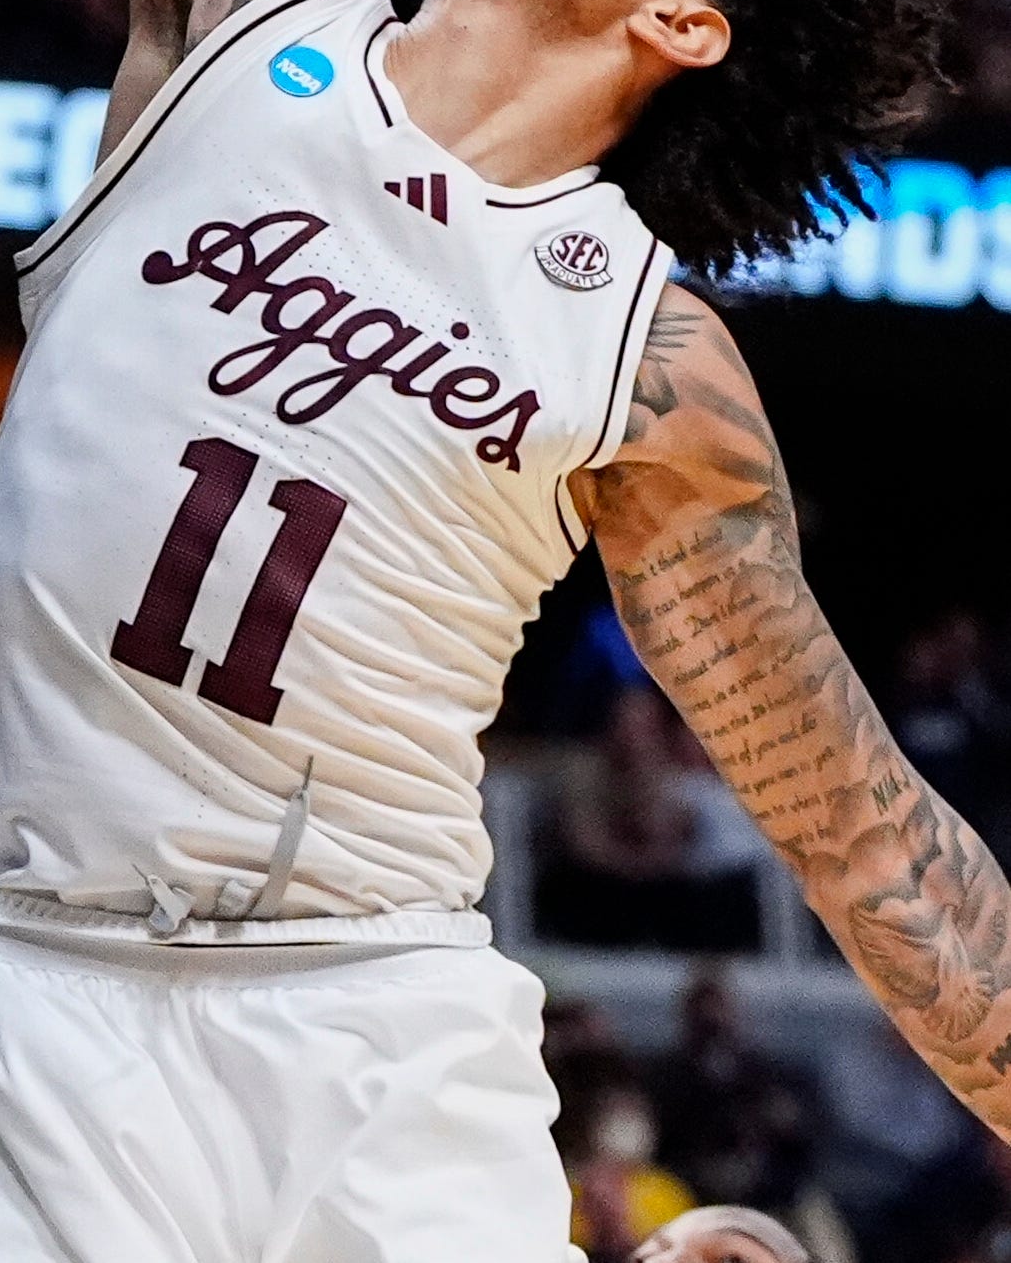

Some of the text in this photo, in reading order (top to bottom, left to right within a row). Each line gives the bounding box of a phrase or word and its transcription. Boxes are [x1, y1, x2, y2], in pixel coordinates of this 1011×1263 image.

[275, 57, 322, 93] NCAA
[556, 234, 604, 271] SEC
[141, 211, 542, 473] Aggies
[110, 437, 348, 727] 11
